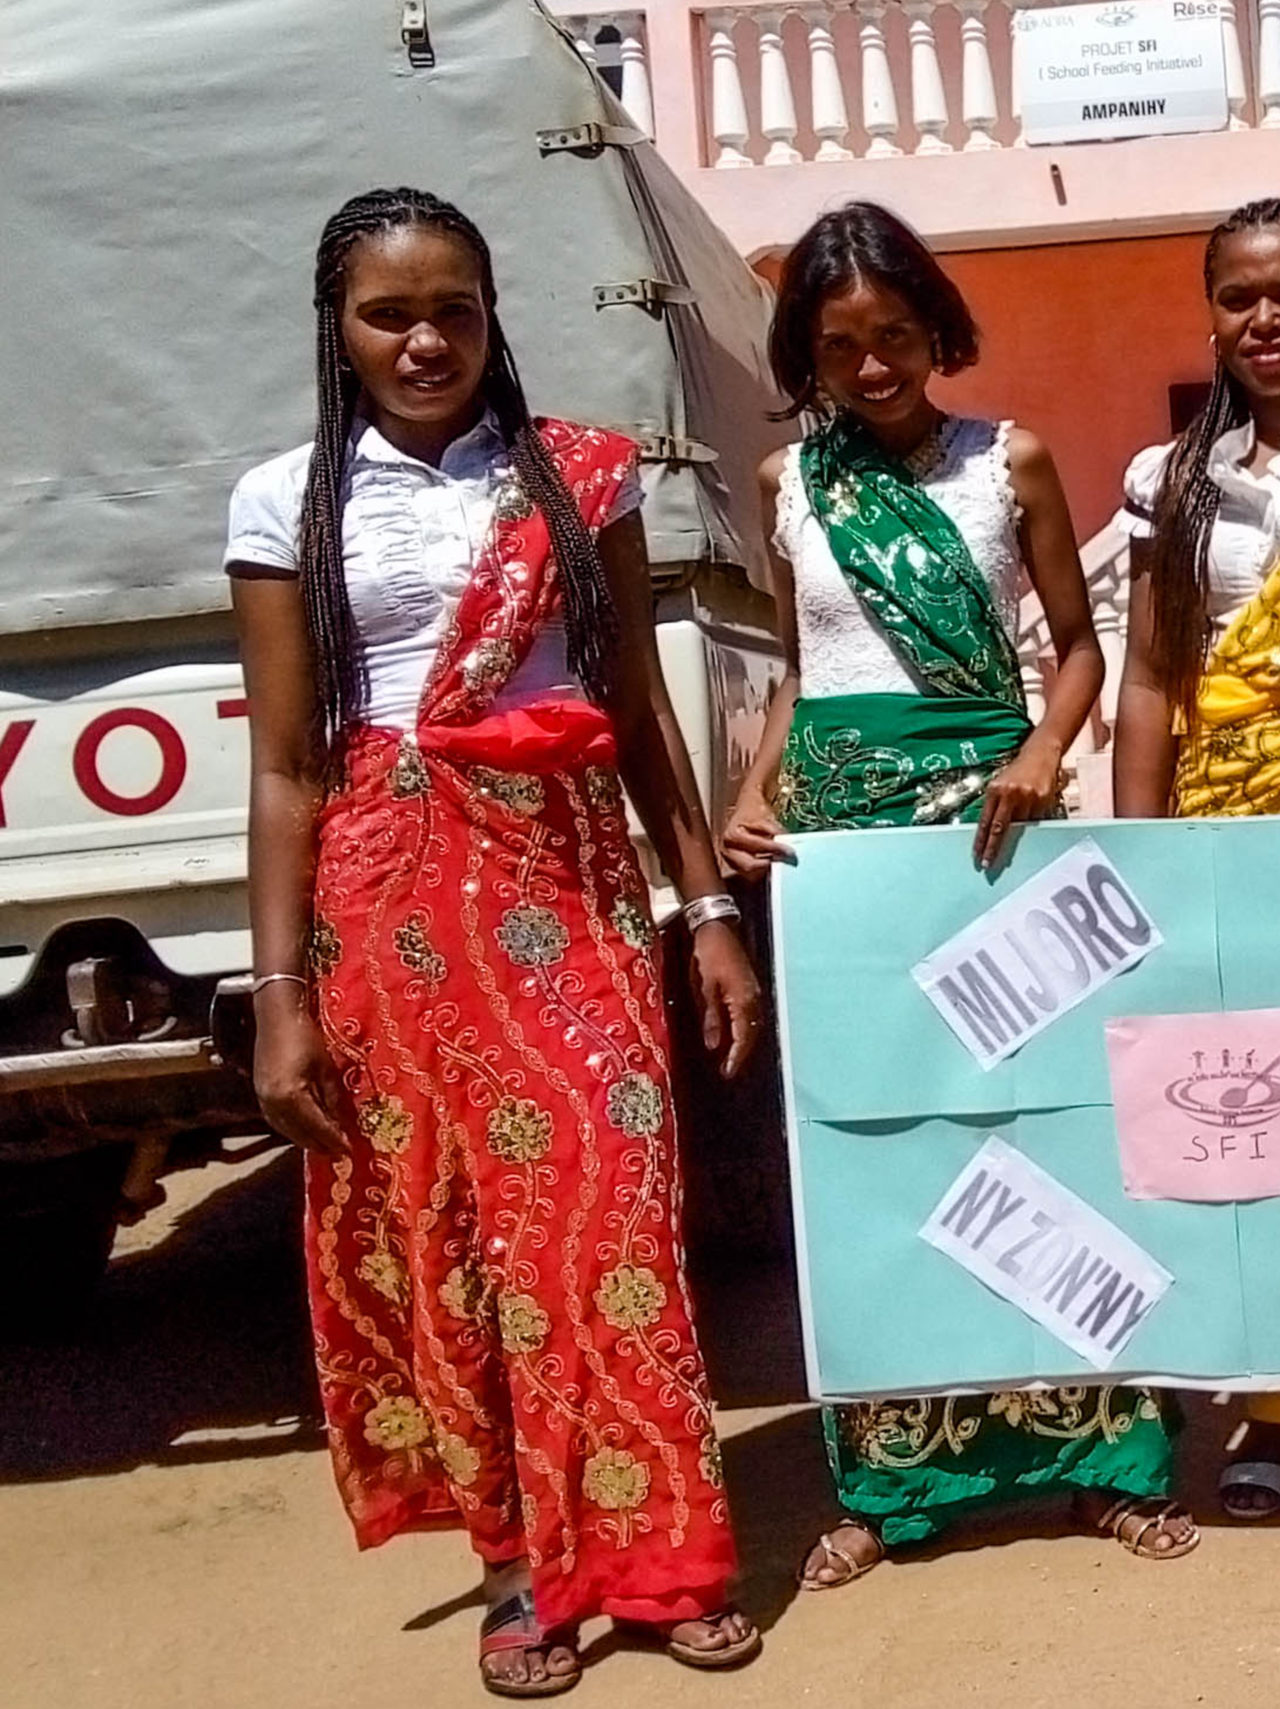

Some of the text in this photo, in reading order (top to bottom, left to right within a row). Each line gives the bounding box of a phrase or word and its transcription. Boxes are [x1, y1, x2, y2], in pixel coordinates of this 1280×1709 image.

[1081, 39, 1157, 58] PROJET SFI
[1047, 63, 1089, 80] School
[1094, 60, 1142, 76] Feeding
[1081, 98, 1167, 121] AMPANIHY
[936, 863, 1151, 1056] MIJORO
[940, 1168, 1028, 1251] NY
